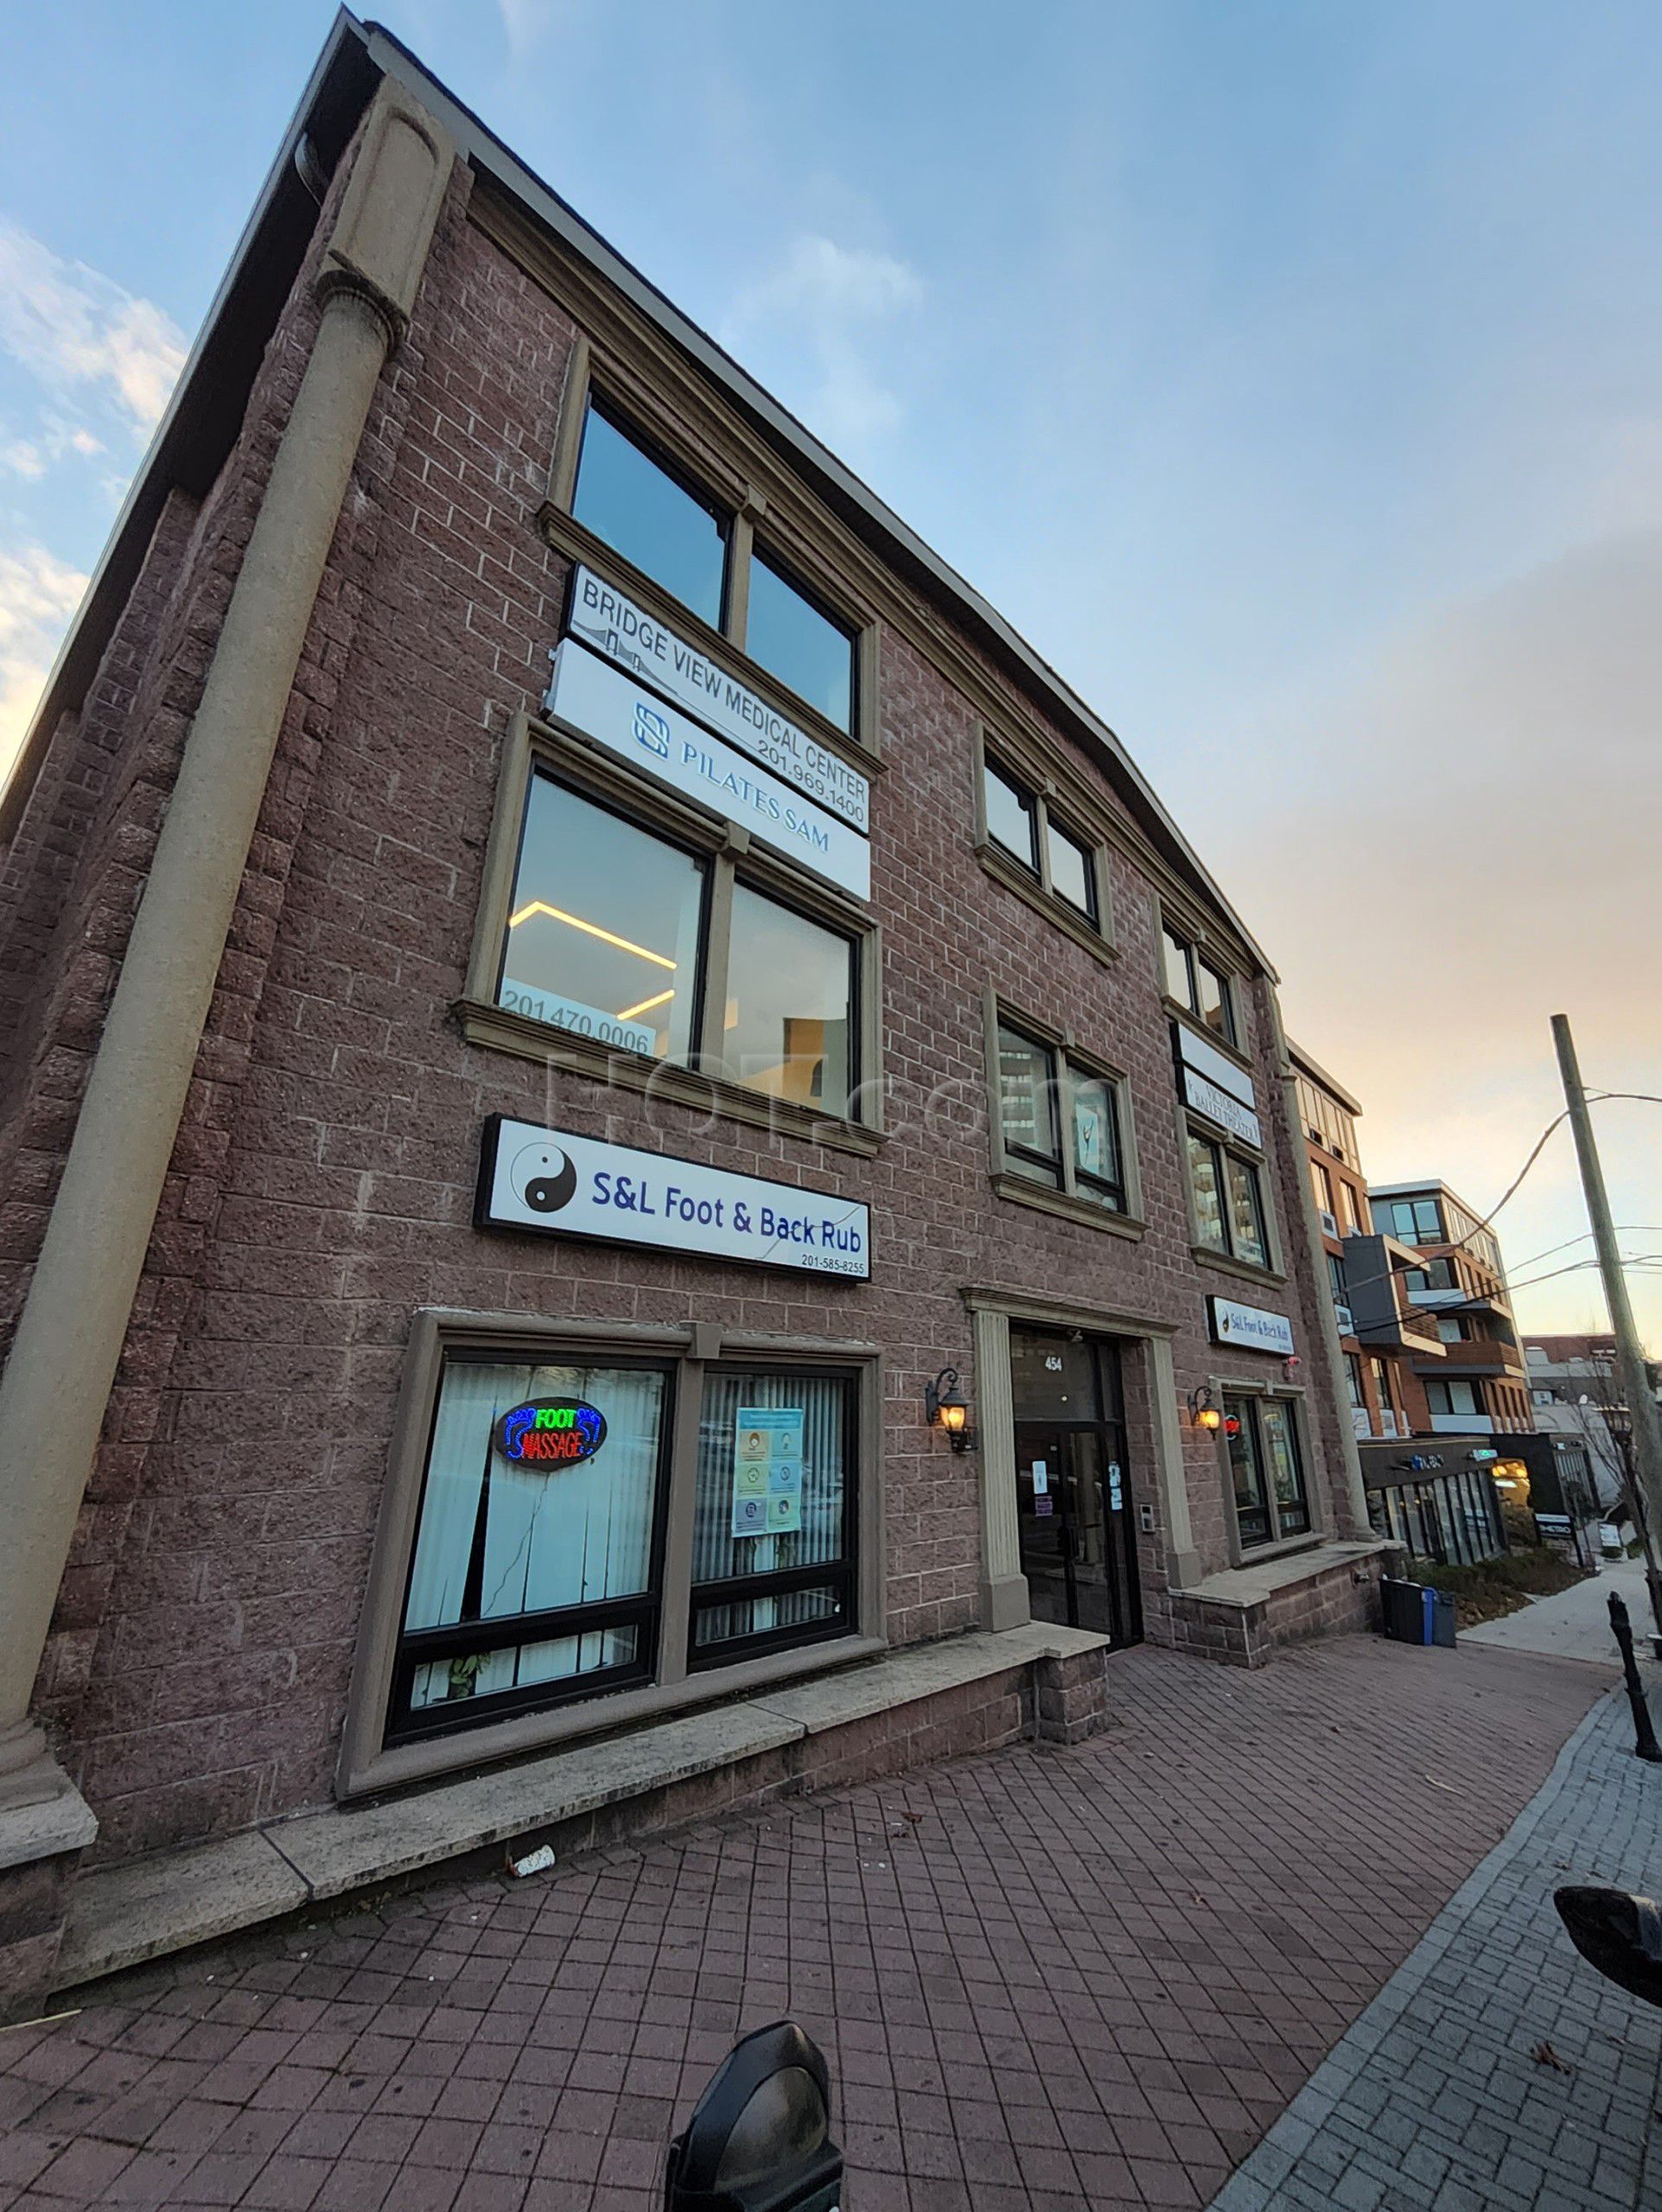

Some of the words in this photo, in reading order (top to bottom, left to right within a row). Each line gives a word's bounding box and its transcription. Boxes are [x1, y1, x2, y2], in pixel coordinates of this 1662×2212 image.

[583, 578, 668, 662] BRIDGE
[673, 644, 722, 698] VIEW
[725, 683, 801, 760] MEDICAL
[806, 745, 865, 804] CENTER
[682, 741, 780, 820] PILATES
[785, 808, 829, 852] SAM
[757, 739, 864, 823] 201.969.1400
[505, 989, 648, 1053] 2014700006
[591, 1172, 656, 1216] S&L
[665, 1186, 723, 1229] Foot
[733, 1201, 753, 1235] &
[761, 1207, 815, 1245] Back
[822, 1219, 862, 1254] Rub
[801, 1254, 865, 1274] 201-585-8255
[1045, 1356, 1062, 1372] 454
[522, 1431, 583, 1459] MASSAGE
[535, 1408, 576, 1428] FOOT
